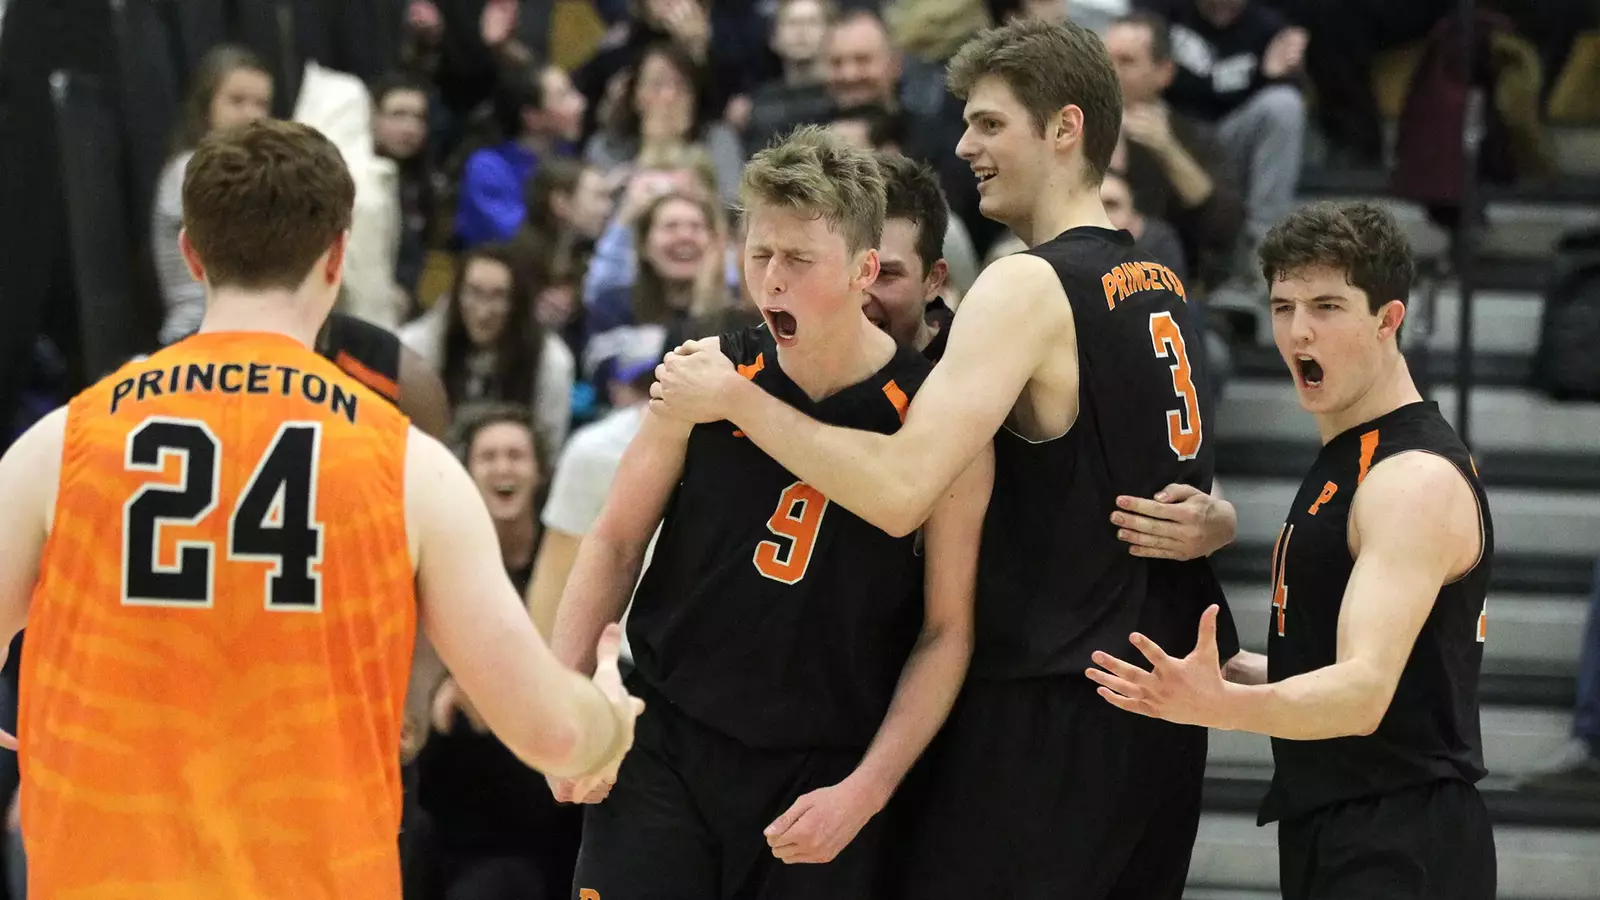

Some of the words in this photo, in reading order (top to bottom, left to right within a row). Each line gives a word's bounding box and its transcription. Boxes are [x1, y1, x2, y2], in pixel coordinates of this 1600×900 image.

[110, 362, 358, 425] PRINCETON
[1149, 311, 1202, 461] 3
[121, 416, 324, 612] 24
[753, 480, 830, 585] 9
[1308, 480, 1338, 515] P
